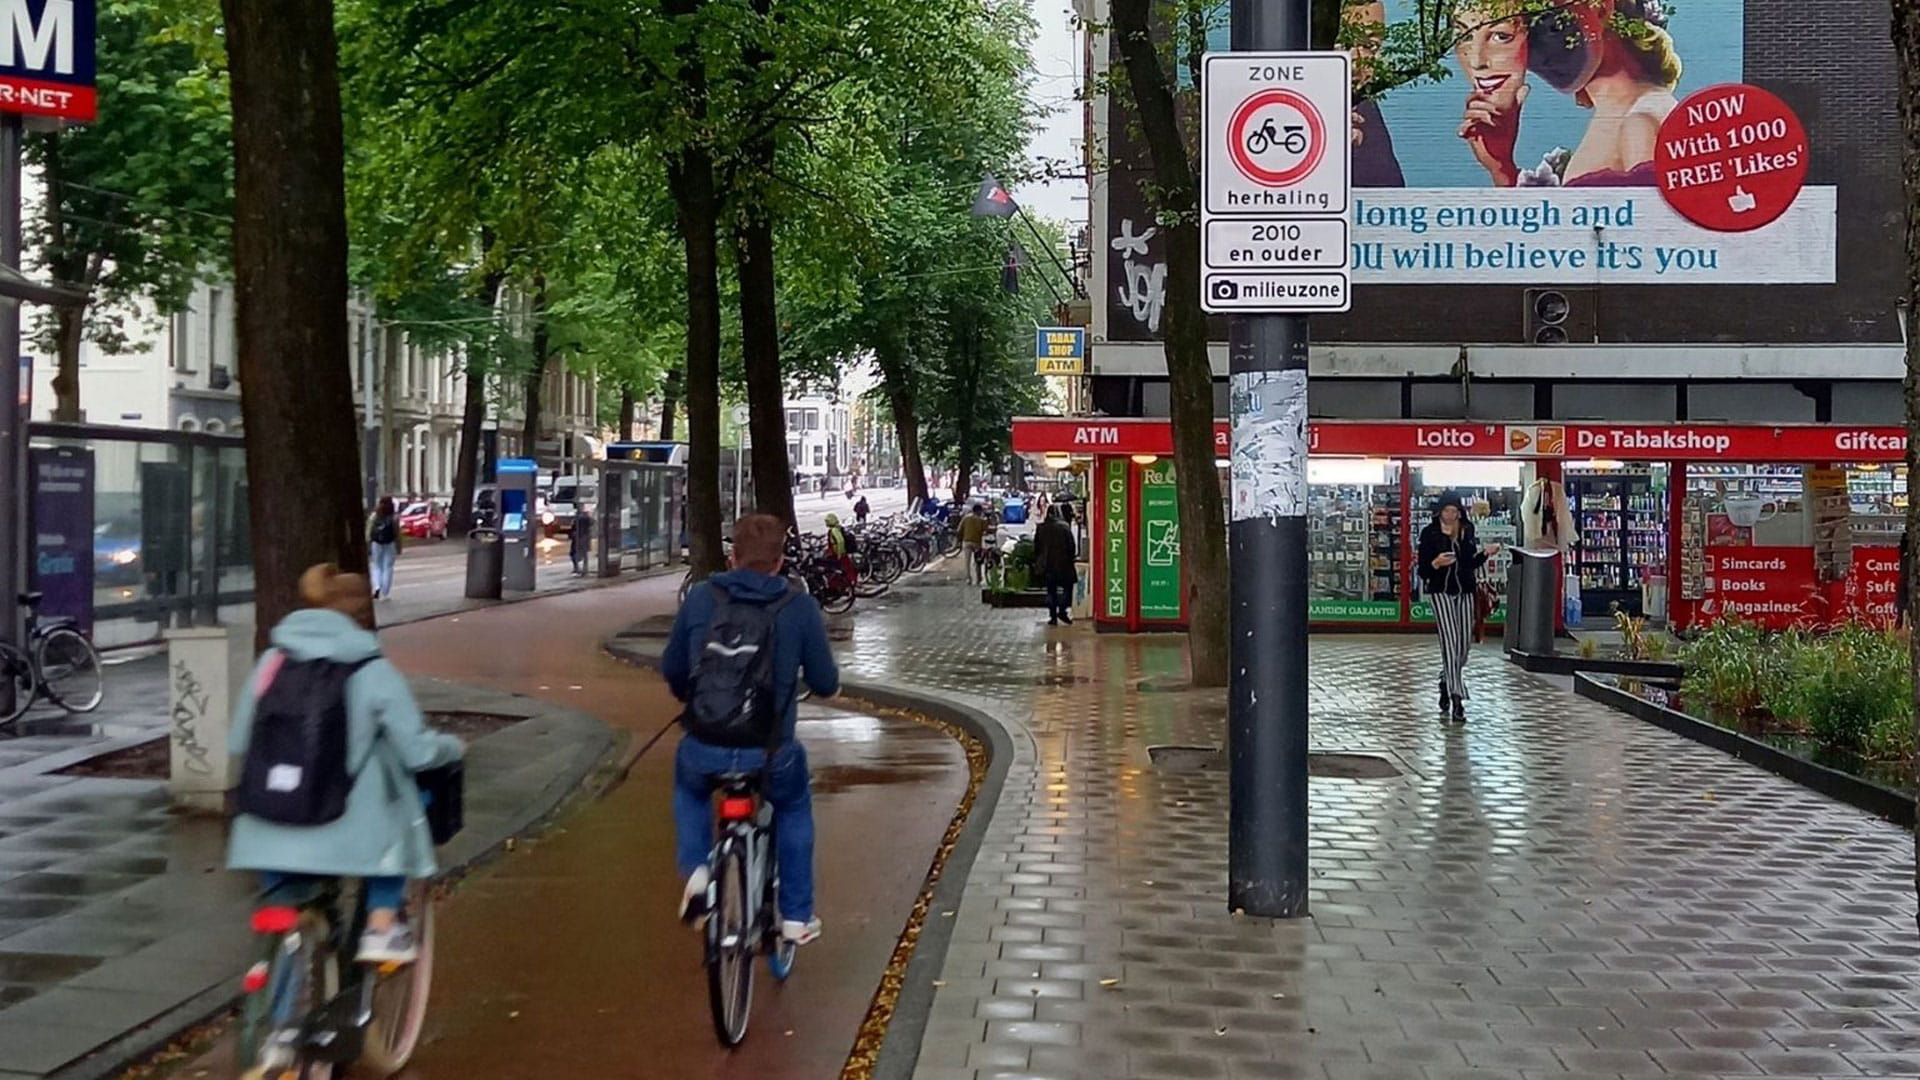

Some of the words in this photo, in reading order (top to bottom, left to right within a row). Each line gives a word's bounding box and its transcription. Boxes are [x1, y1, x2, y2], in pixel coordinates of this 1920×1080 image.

[0, 0, 73, 74] M
[1249, 67, 1304, 81] ZONE
[1687, 93, 1745, 126] NOW
[1665, 133, 1721, 160] With
[1726, 118, 1787, 148] 1000
[1666, 162, 1724, 190] FREE
[1228, 190, 1329, 209] herhaling
[1356, 199, 1428, 233] long
[1436, 199, 1560, 233] enough
[1571, 200, 1633, 226] and
[1251, 225, 1301, 241] 2010
[1230, 249, 1253, 261] en
[1261, 246, 1323, 261] ouder
[1392, 242, 1455, 269] will
[1464, 242, 1586, 269] believe
[1655, 248, 1718, 275] you
[1243, 282, 1340, 298] milieuzone
[1048, 345, 1074, 356] SHOP
[1046, 360, 1076, 371] ATM
[1074, 427, 1119, 444] ATM
[1417, 428, 1475, 447] Lotto
[1577, 430, 1606, 448] De
[1610, 430, 1730, 453] Tabakshop
[1721, 557, 1787, 571] Simcards
[1721, 578, 1766, 592] Books
[1722, 599, 1799, 615] Magazines
